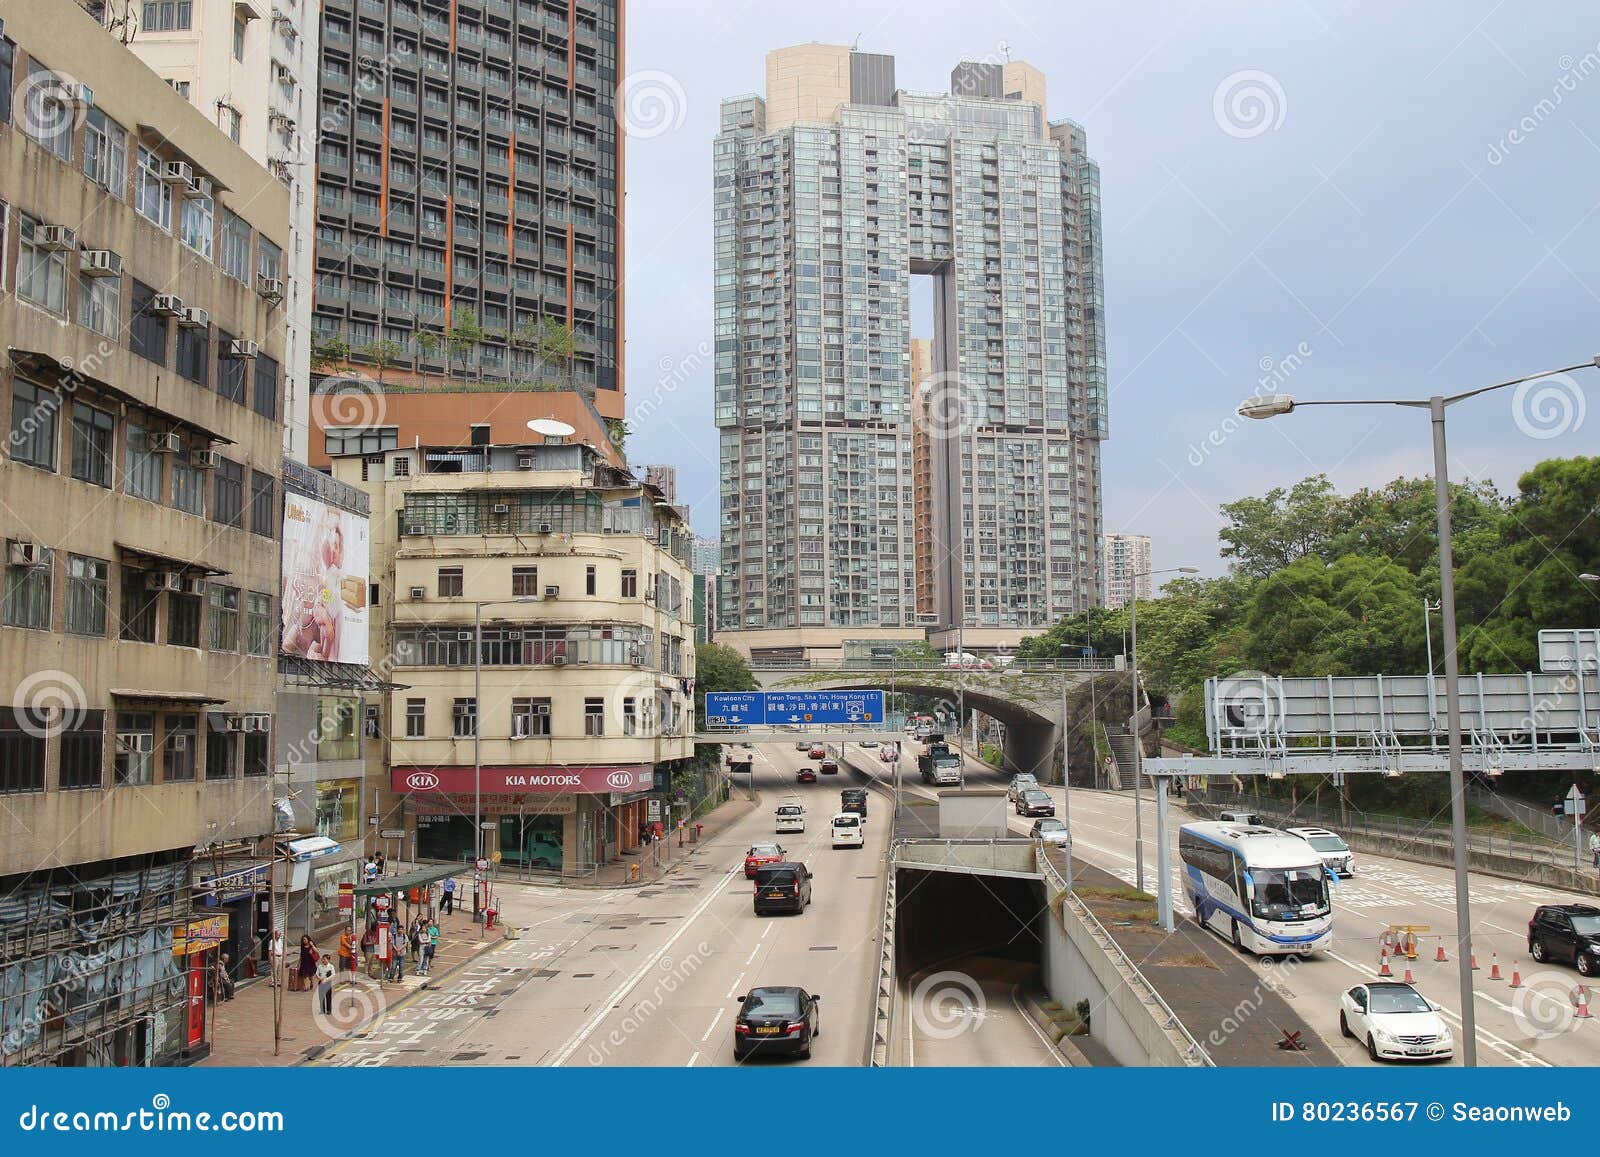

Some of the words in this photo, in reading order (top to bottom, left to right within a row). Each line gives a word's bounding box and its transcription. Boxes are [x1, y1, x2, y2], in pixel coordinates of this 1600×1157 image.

[742, 694, 756, 702] City
[831, 694, 848, 702] Hong
[505, 775, 527, 785] KIA
[529, 775, 581, 785] MOTORS
